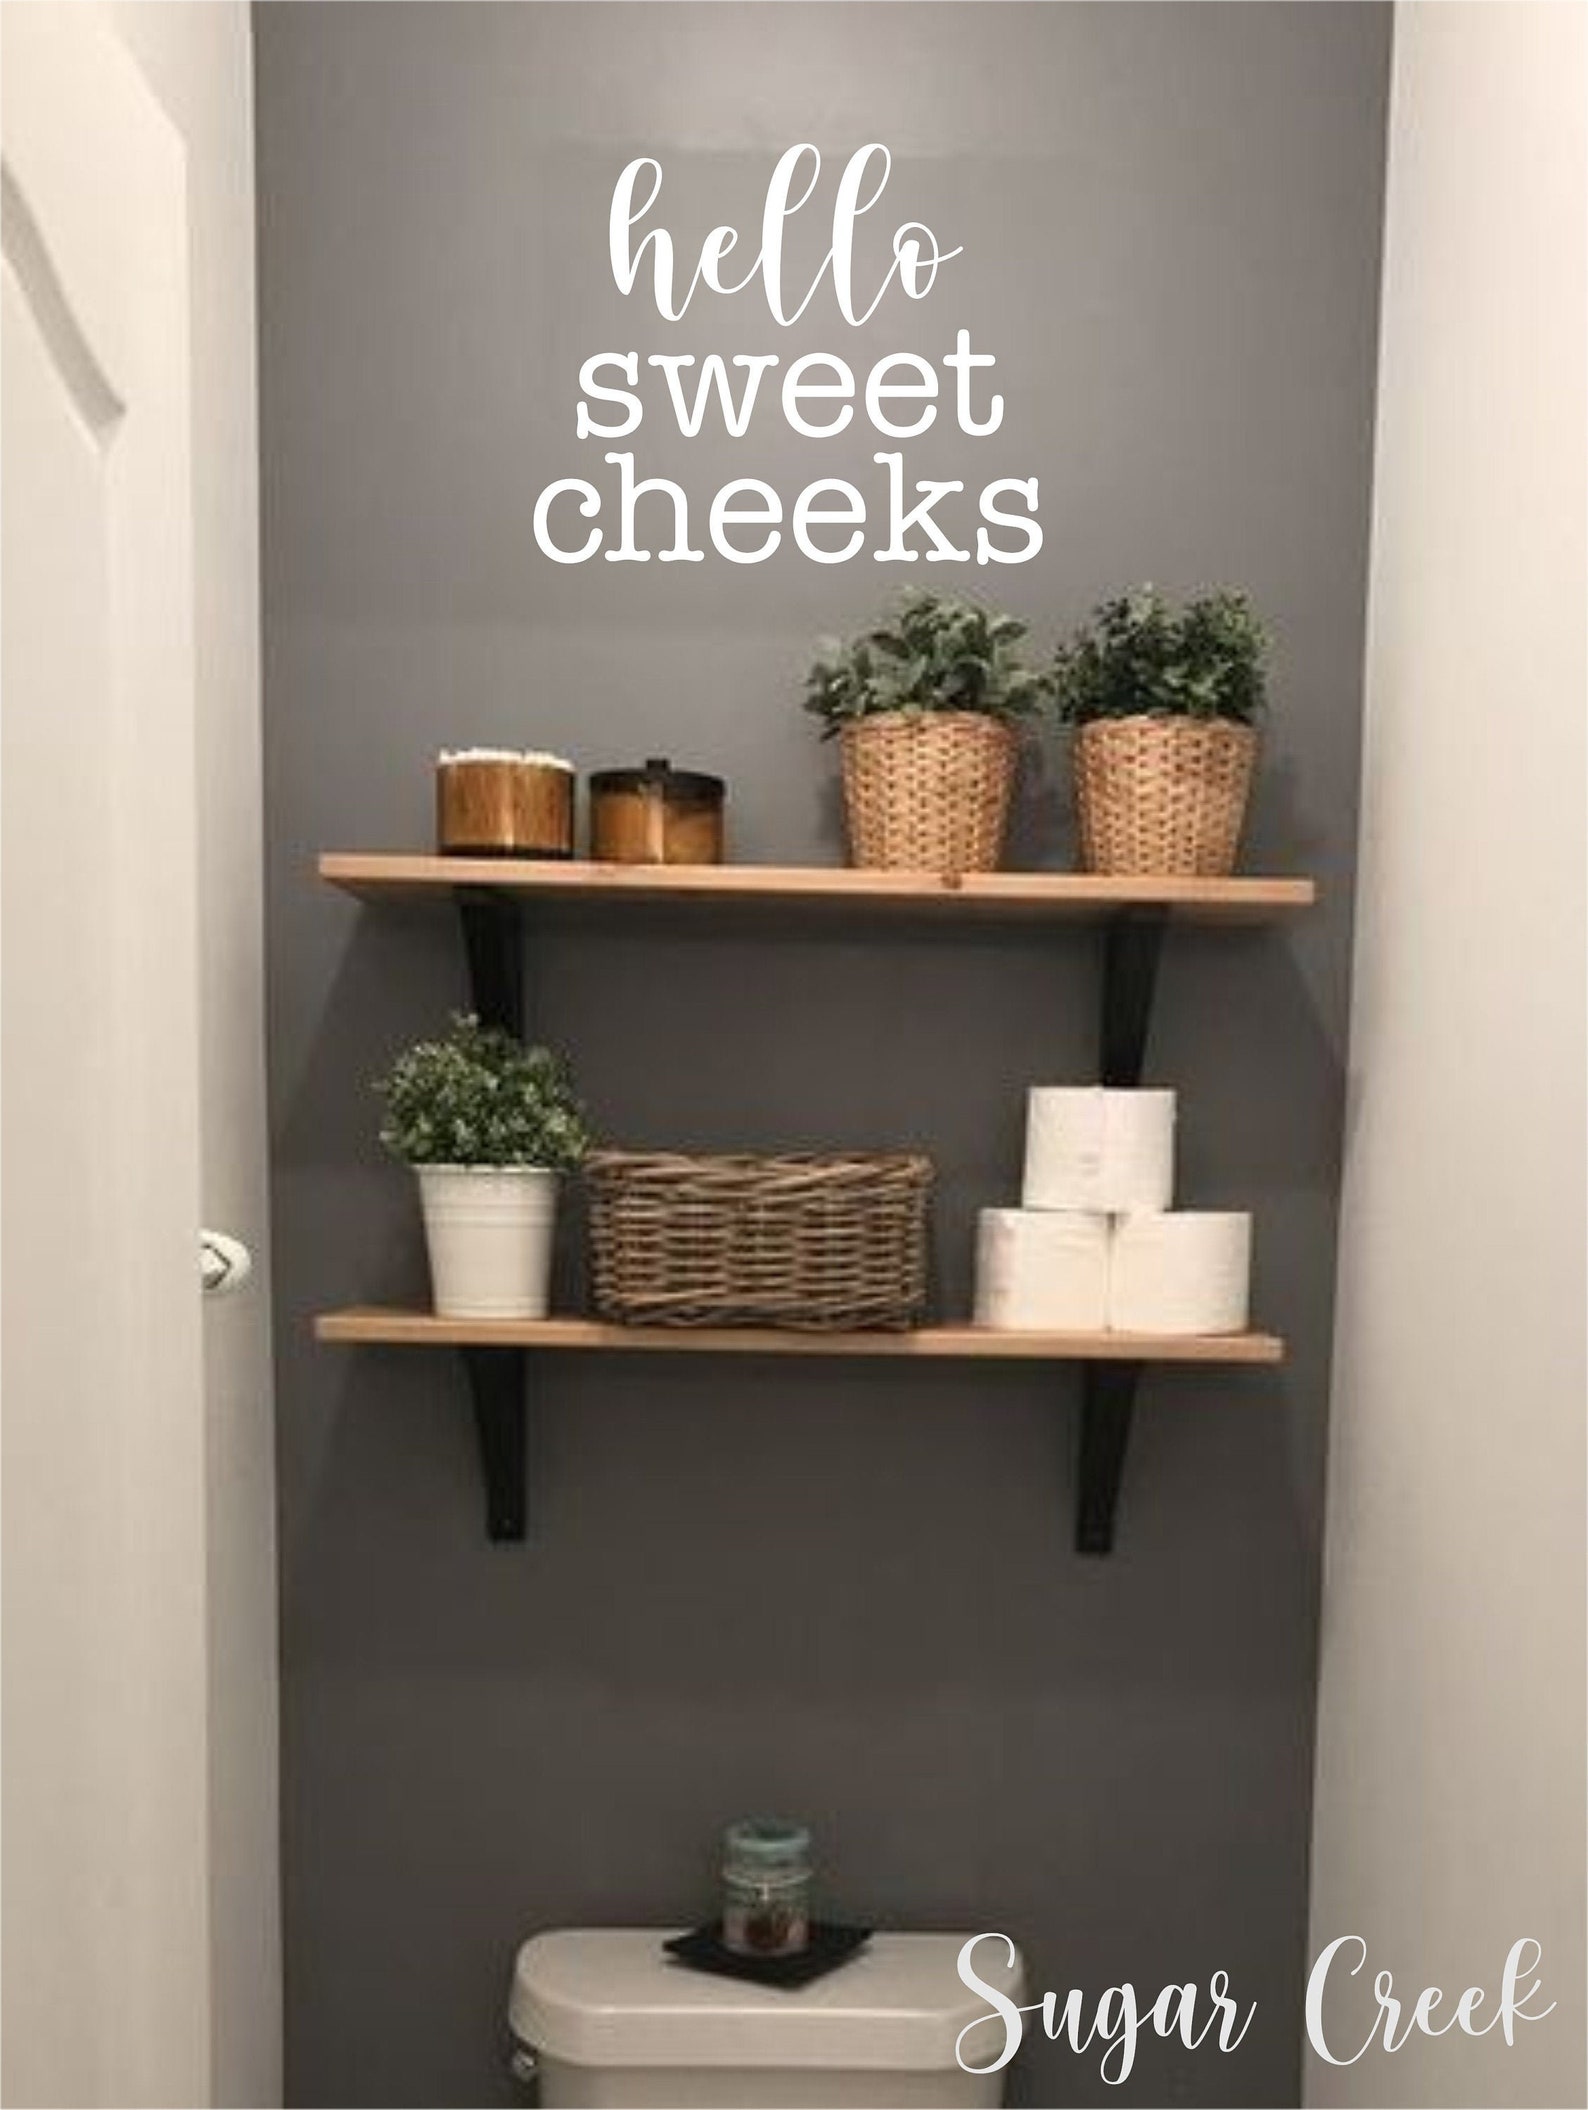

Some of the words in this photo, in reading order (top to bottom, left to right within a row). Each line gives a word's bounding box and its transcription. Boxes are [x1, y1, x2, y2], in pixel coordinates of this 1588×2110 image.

[609, 143, 964, 327] hello
[576, 329, 1004, 440] sweet
[533, 451, 1044, 566] cheeks
